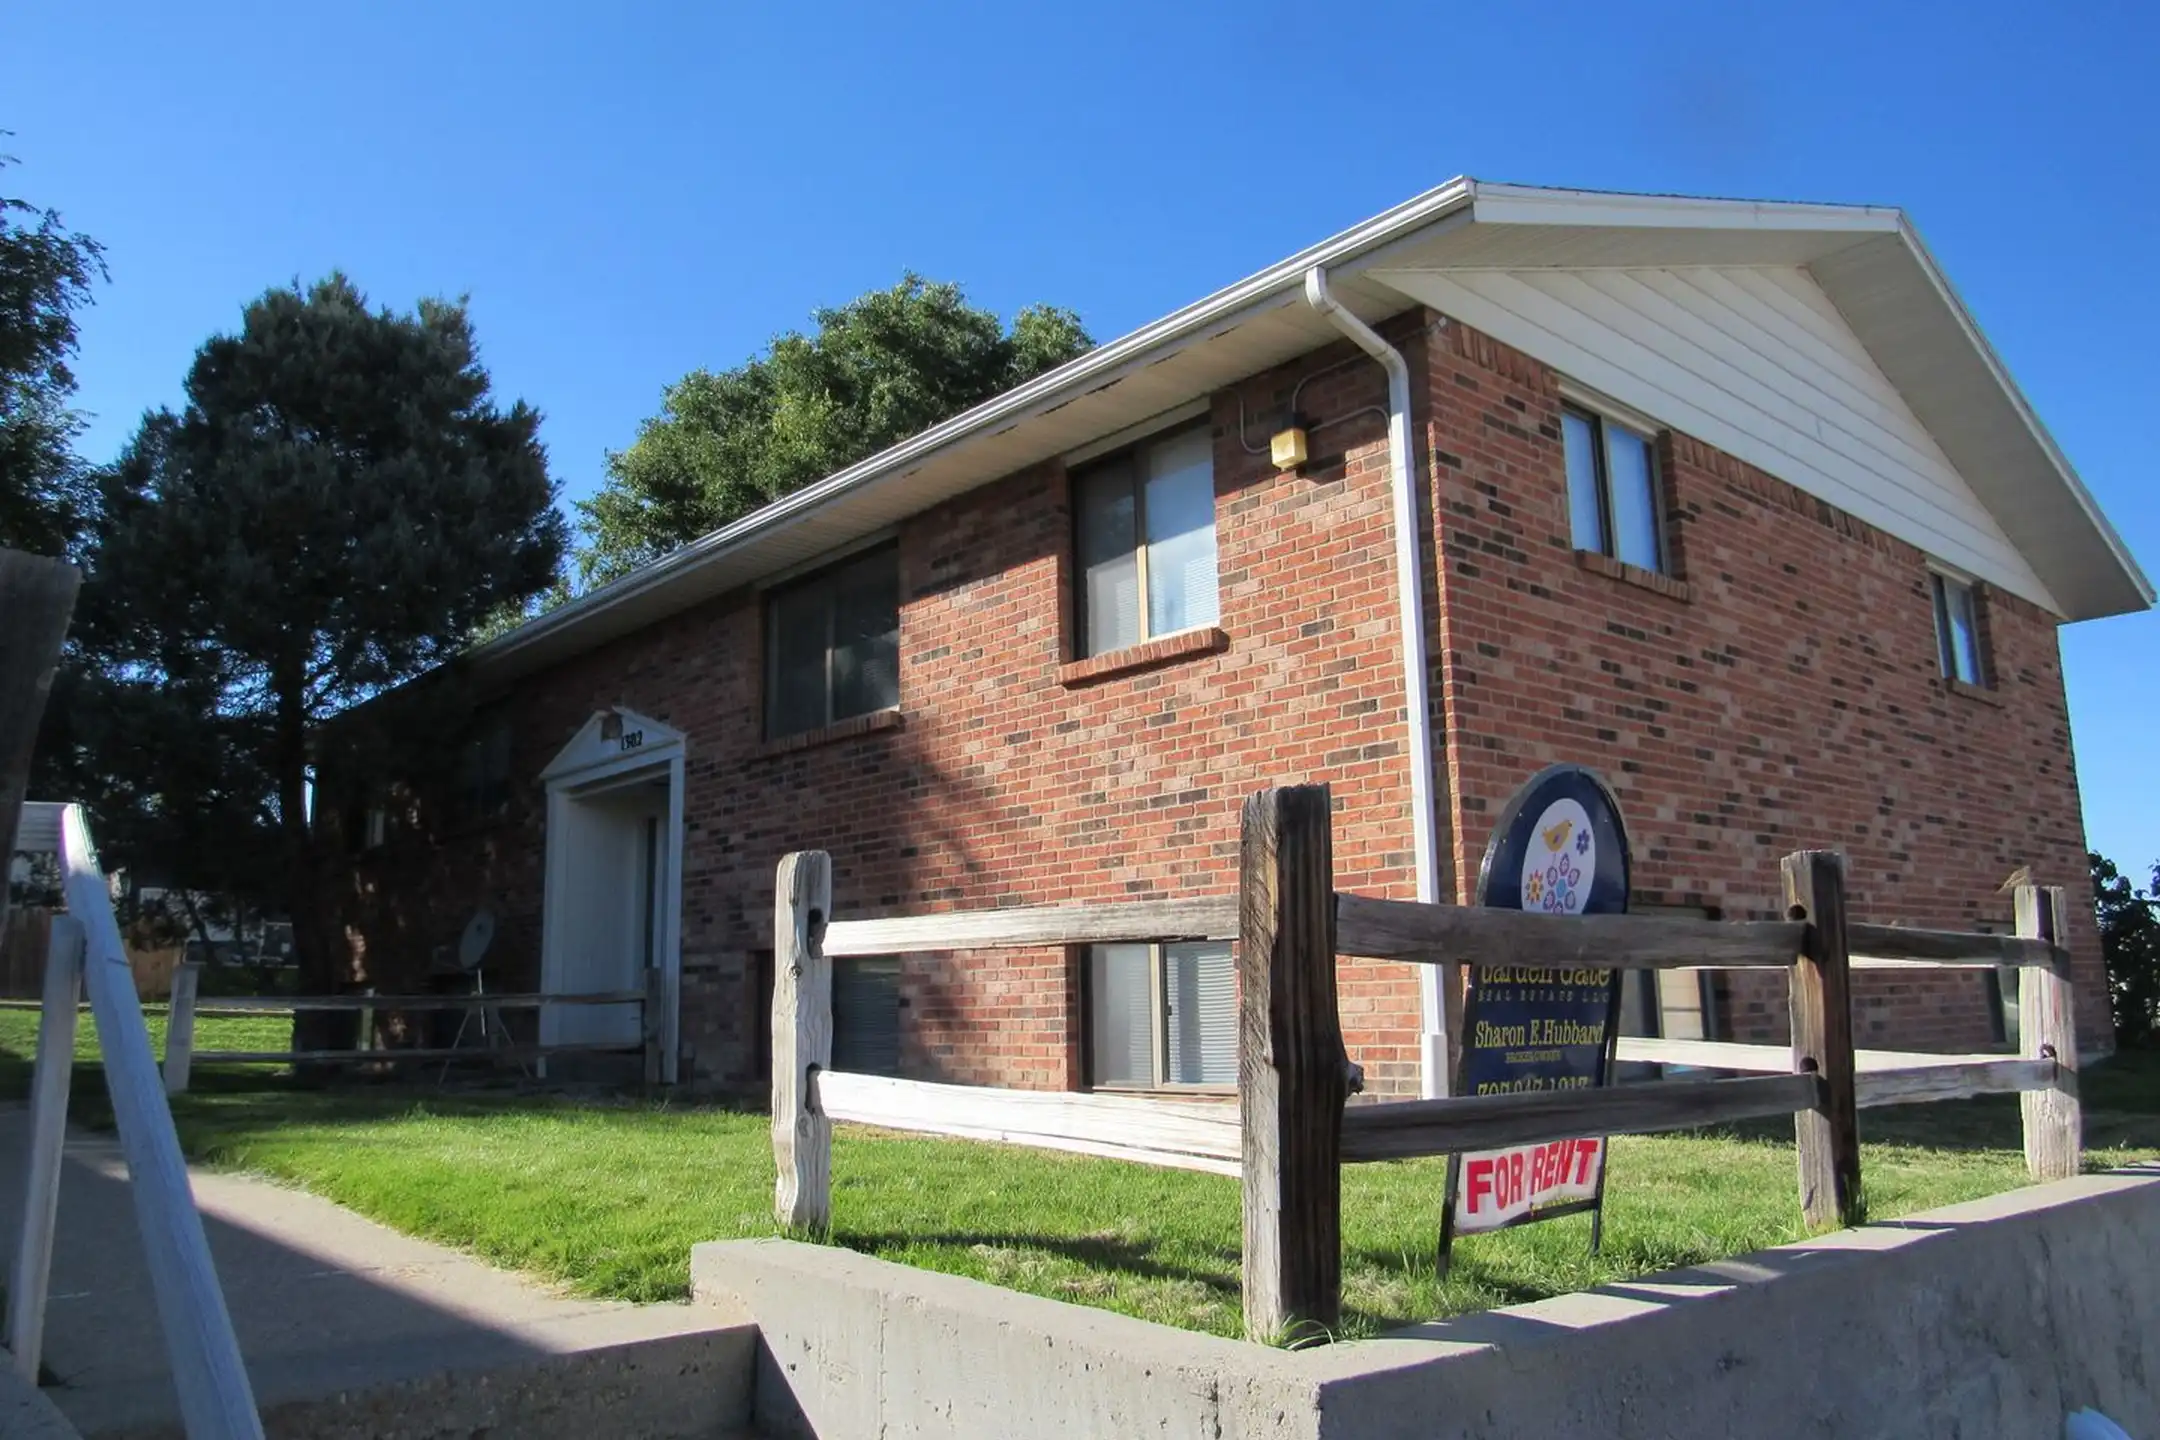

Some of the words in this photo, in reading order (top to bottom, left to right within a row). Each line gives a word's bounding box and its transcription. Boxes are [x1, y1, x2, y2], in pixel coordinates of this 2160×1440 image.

[1475, 1020, 1525, 1049] Sharon
[1467, 1152, 1524, 1214] FOR
[1530, 1139, 1599, 1196] RENT
